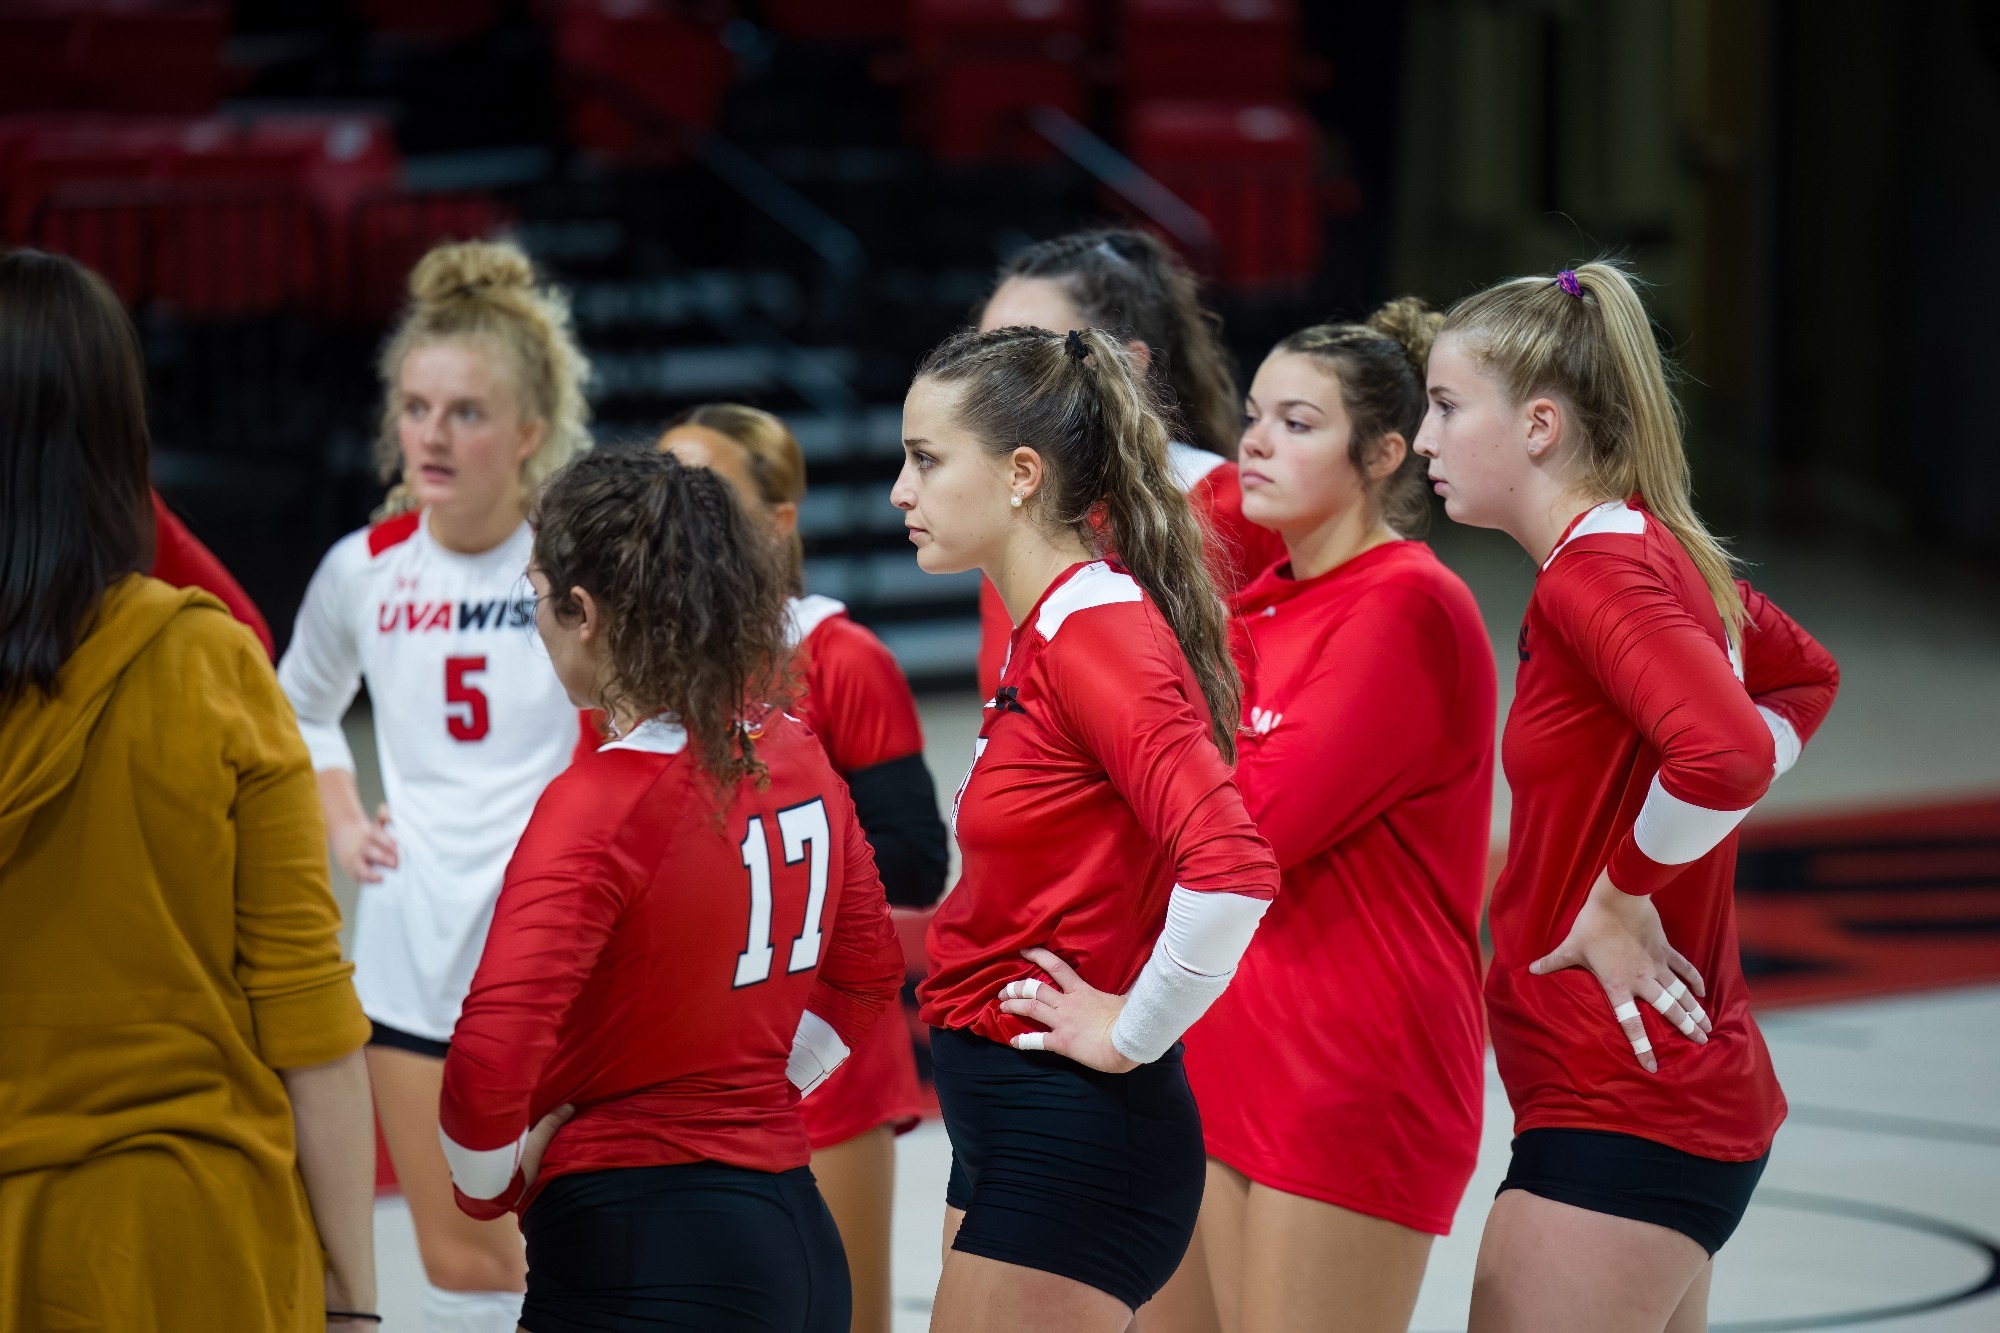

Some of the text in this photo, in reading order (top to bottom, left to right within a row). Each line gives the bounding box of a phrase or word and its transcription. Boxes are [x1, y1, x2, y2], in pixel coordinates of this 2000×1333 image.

[378, 600, 538, 633] UVAWIS
[445, 656, 490, 743] 5
[731, 795, 830, 990] 17
